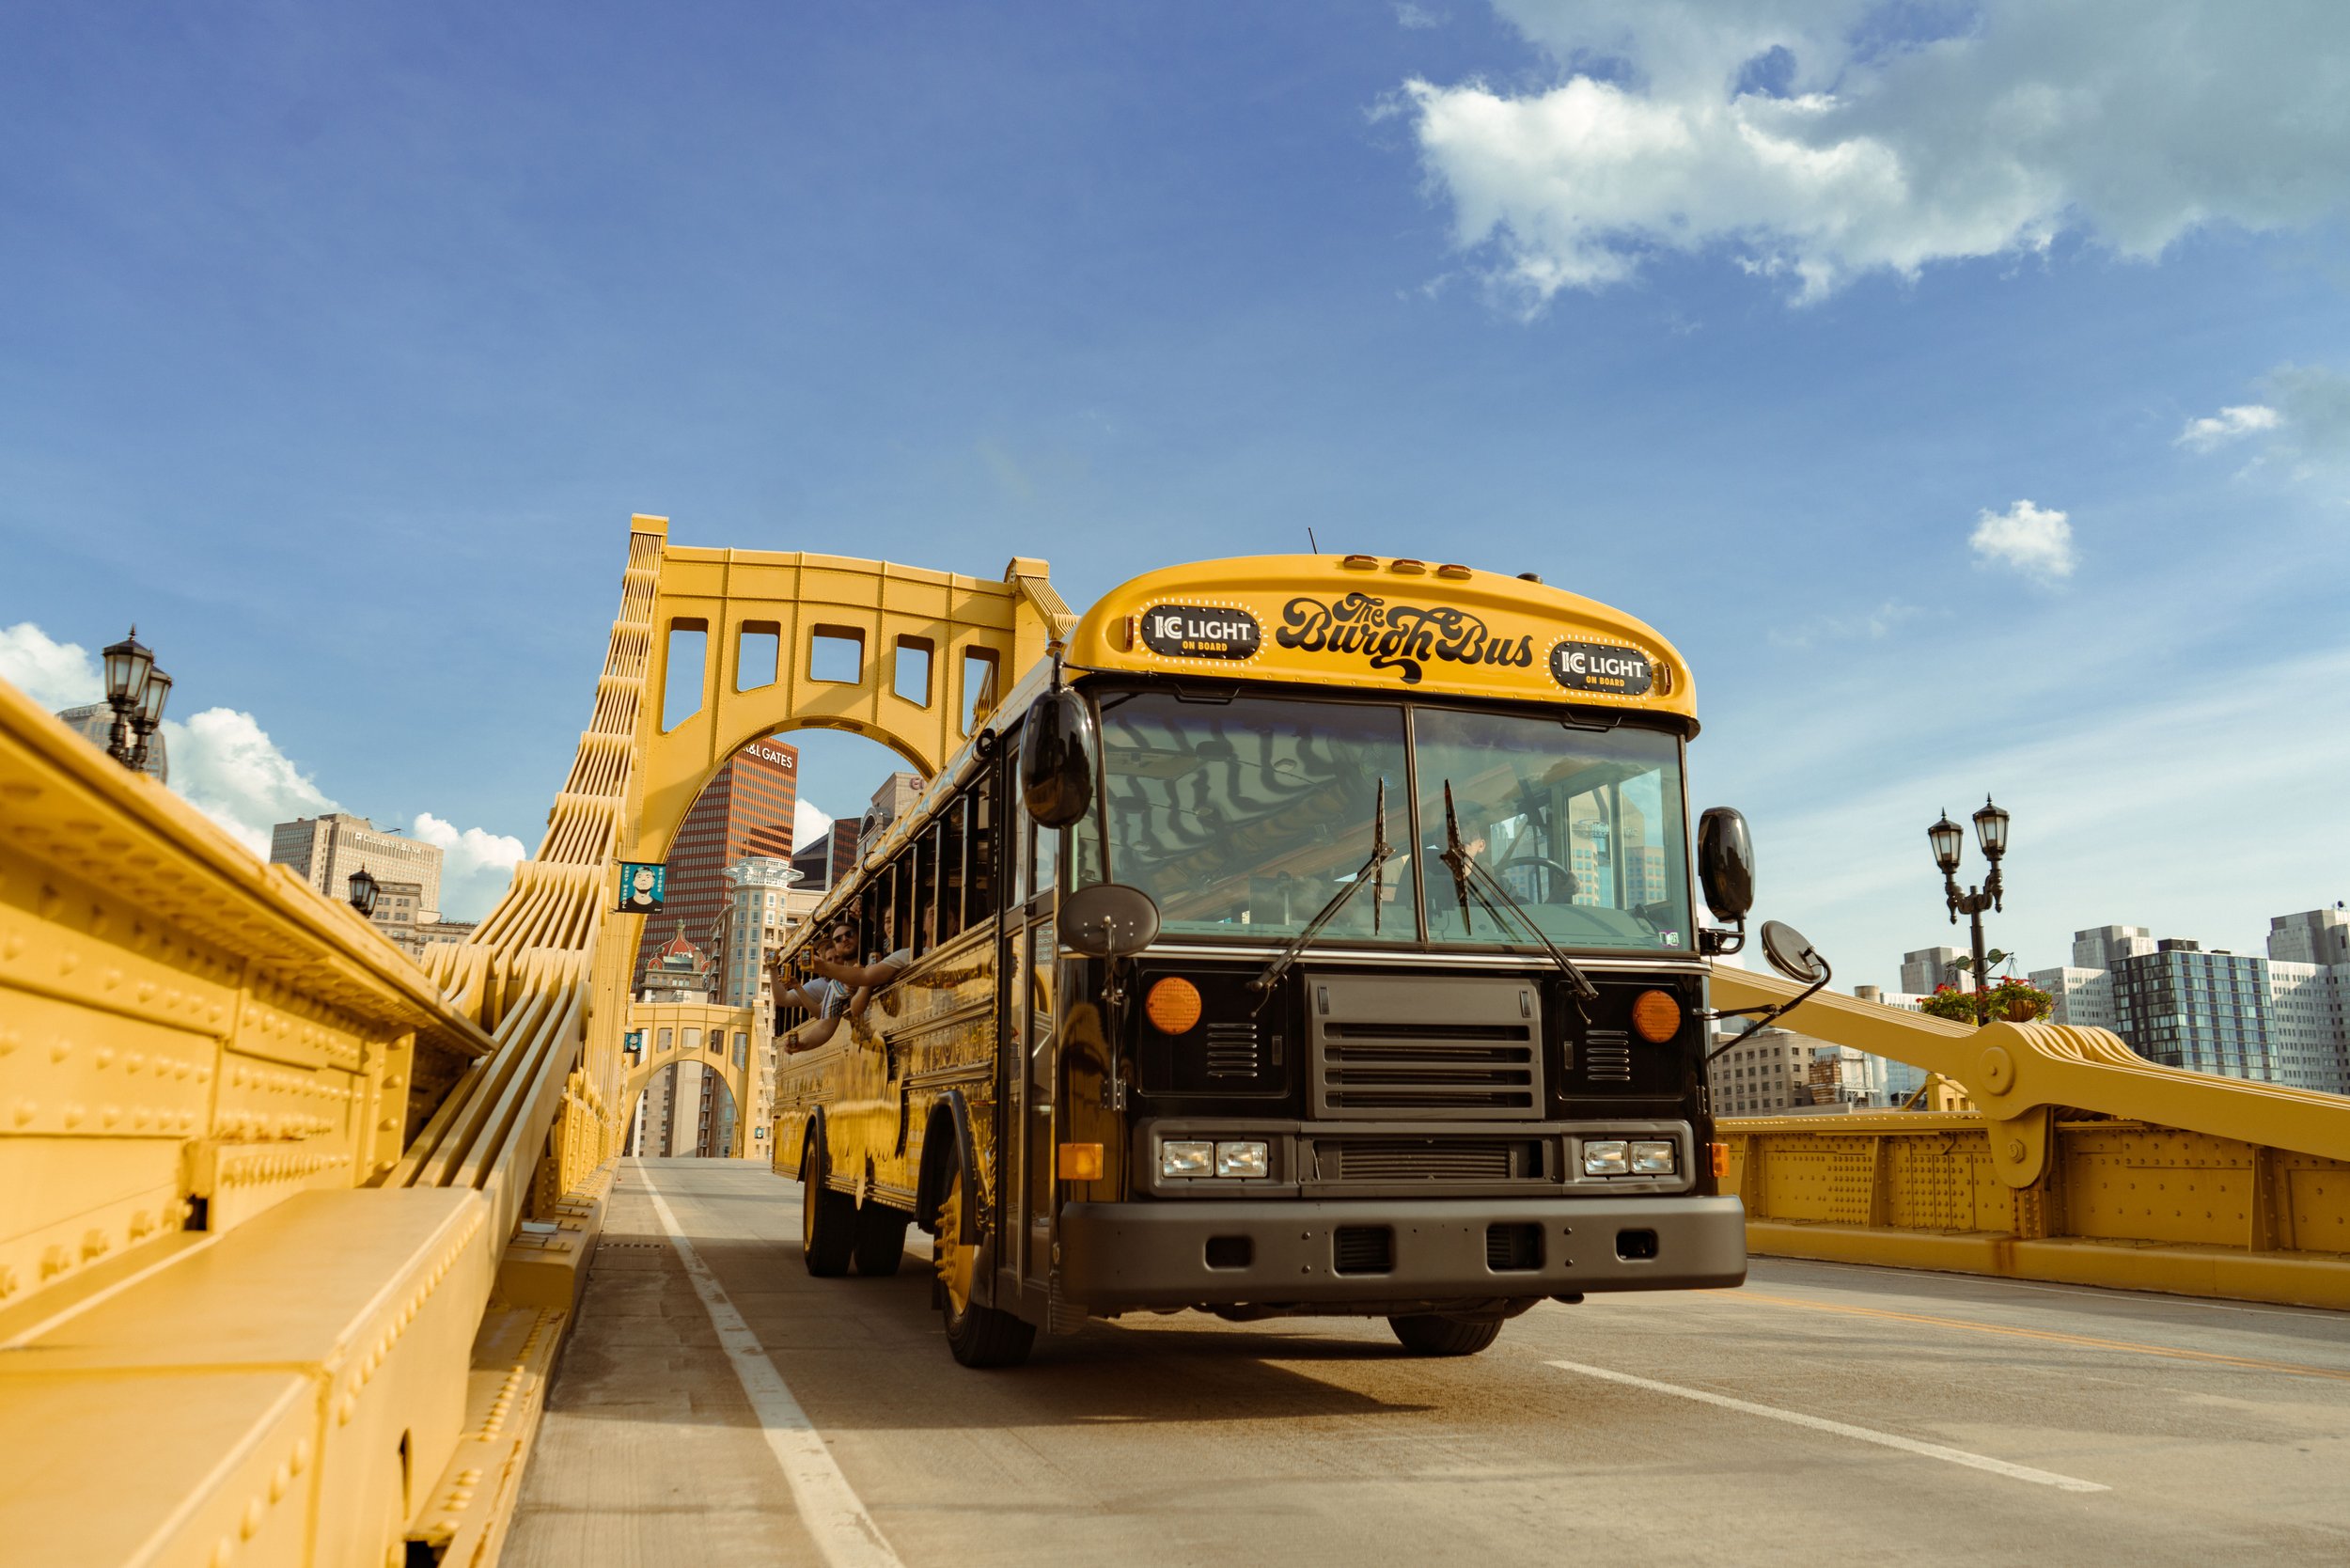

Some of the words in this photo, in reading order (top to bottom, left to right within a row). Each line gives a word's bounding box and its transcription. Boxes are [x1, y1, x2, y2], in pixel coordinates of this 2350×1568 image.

[1332, 592, 1385, 627] The
[1154, 615, 1183, 639] IC
[1188, 620, 1251, 641] LIGHT
[1276, 597, 1441, 684] Burgh
[1432, 606, 1533, 667] Bus
[1183, 641, 1195, 651] ON
[1198, 641, 1228, 651] BOARD
[1561, 651, 1586, 674] IC
[1590, 656, 1644, 678] LIGHT
[1586, 676, 1597, 684] ON
[1599, 677, 1625, 687] BOARD
[762, 747, 792, 768] GATES
